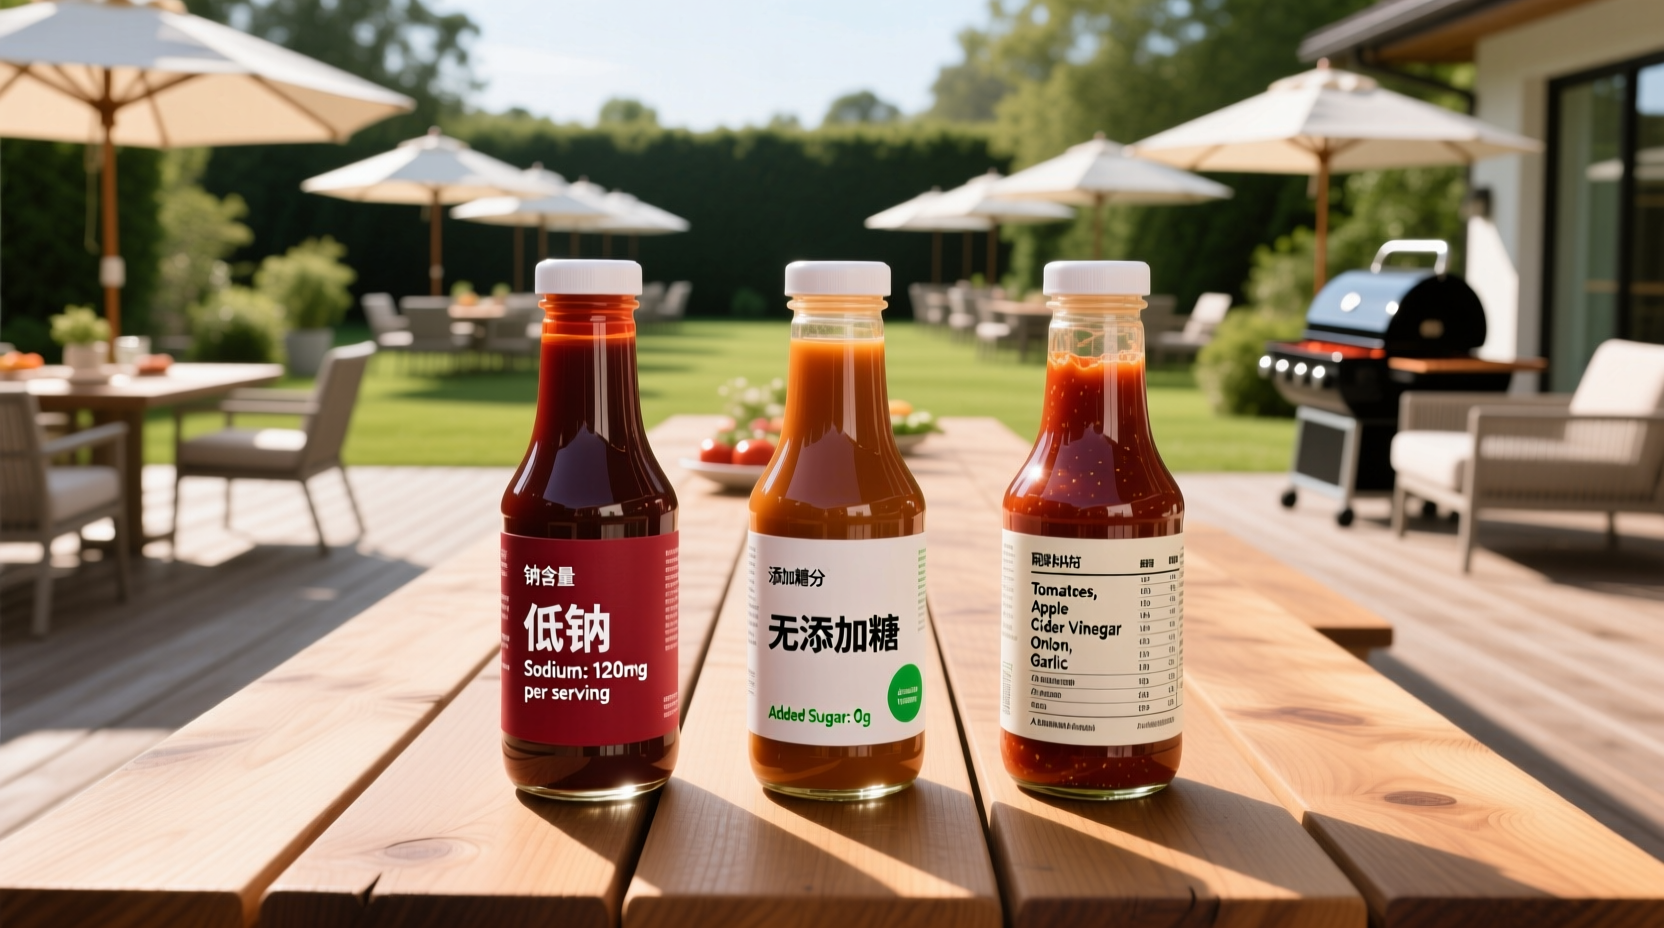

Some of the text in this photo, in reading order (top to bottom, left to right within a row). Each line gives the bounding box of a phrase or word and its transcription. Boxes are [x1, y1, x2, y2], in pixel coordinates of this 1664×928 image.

[523, 564, 576, 587] 钠含量
[1031, 600, 1069, 618] Apple
[523, 603, 610, 653] 低钠
[768, 613, 900, 654] 无添加糖
[1031, 618, 1122, 640] Cider Vinegar
[523, 660, 648, 681] Sodium: 120mg
[1030, 653, 1069, 670] Garlic
[524, 685, 610, 704] per serving
[768, 705, 871, 727] Added Sugar: 0g
